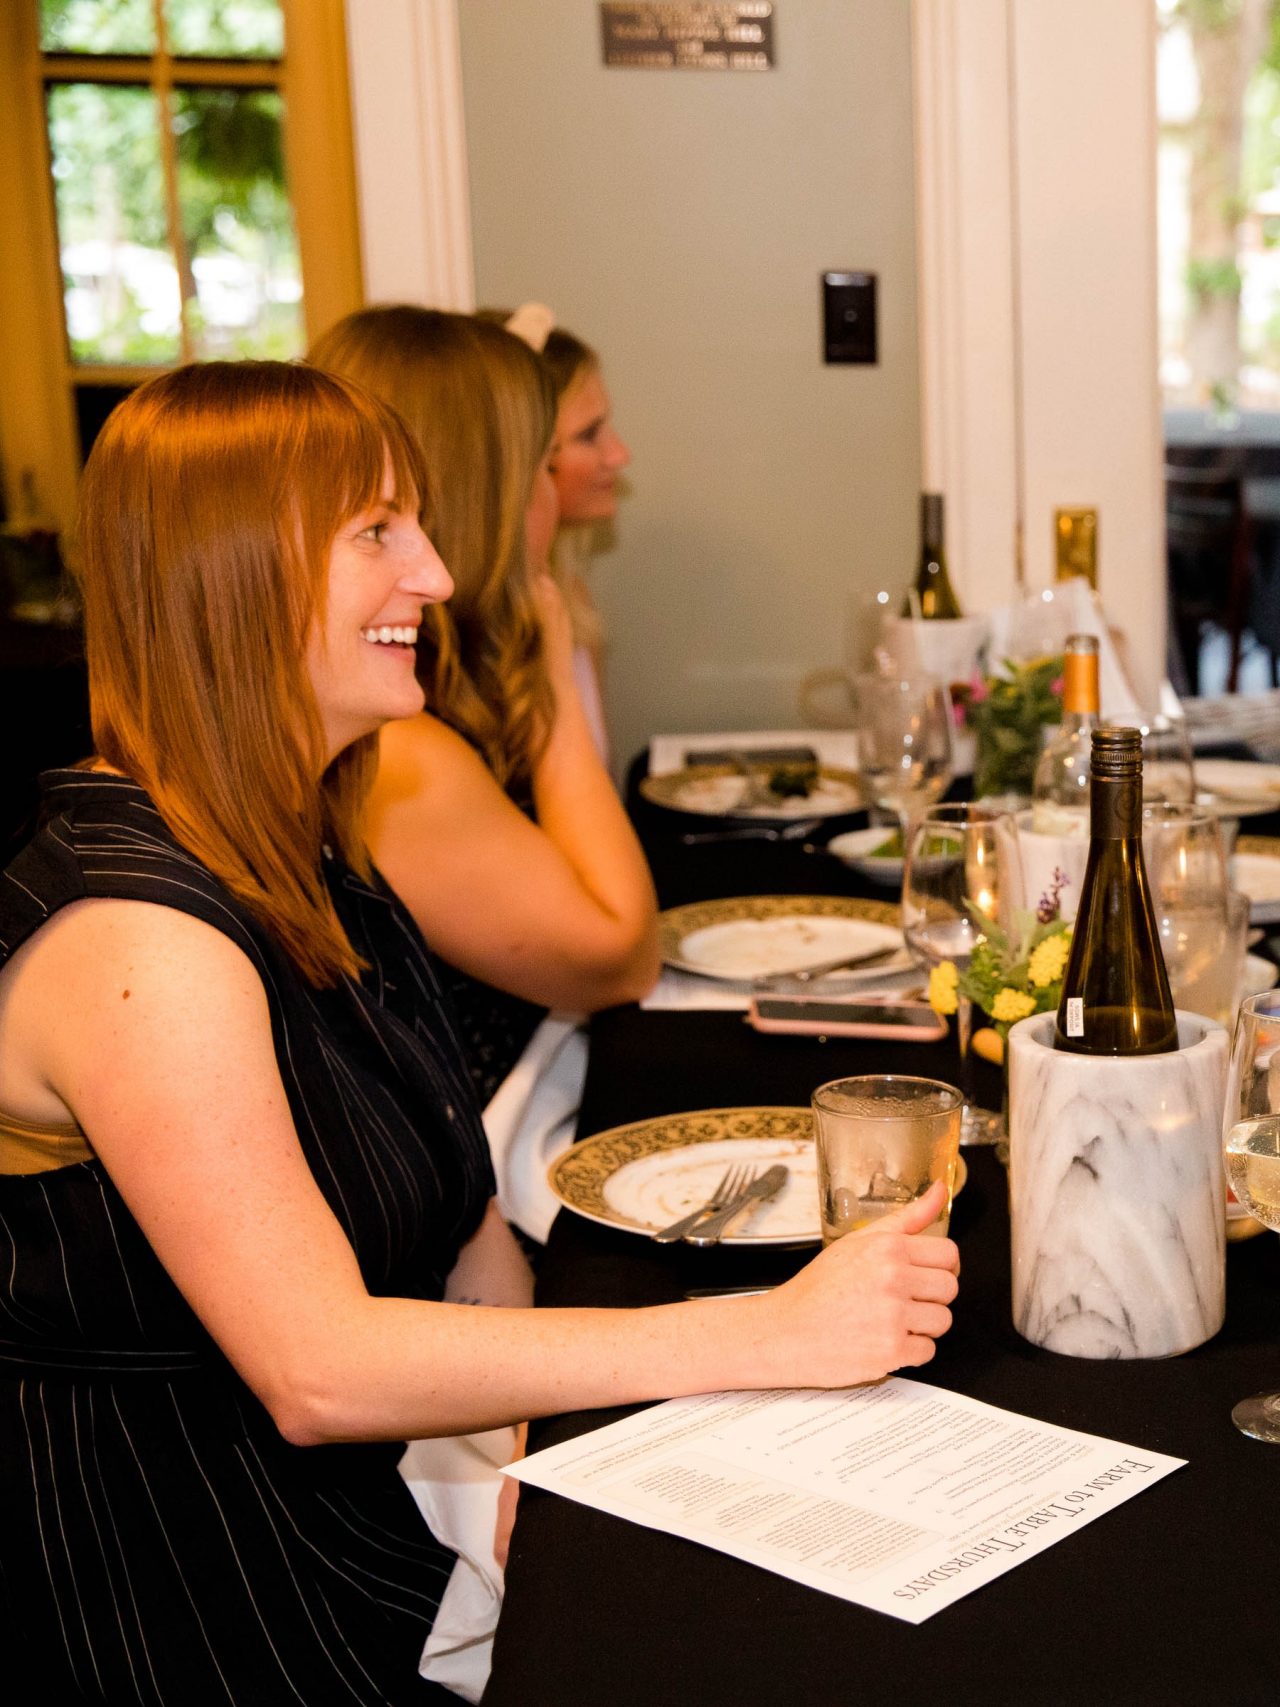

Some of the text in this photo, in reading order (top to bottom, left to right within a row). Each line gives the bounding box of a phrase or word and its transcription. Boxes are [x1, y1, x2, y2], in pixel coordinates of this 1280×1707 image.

[1084, 1458, 1155, 1492] FARM
[1064, 1490, 1095, 1505] to
[1004, 1502, 1086, 1538] TABLE
[893, 1536, 1026, 1600] THURSDAYS
